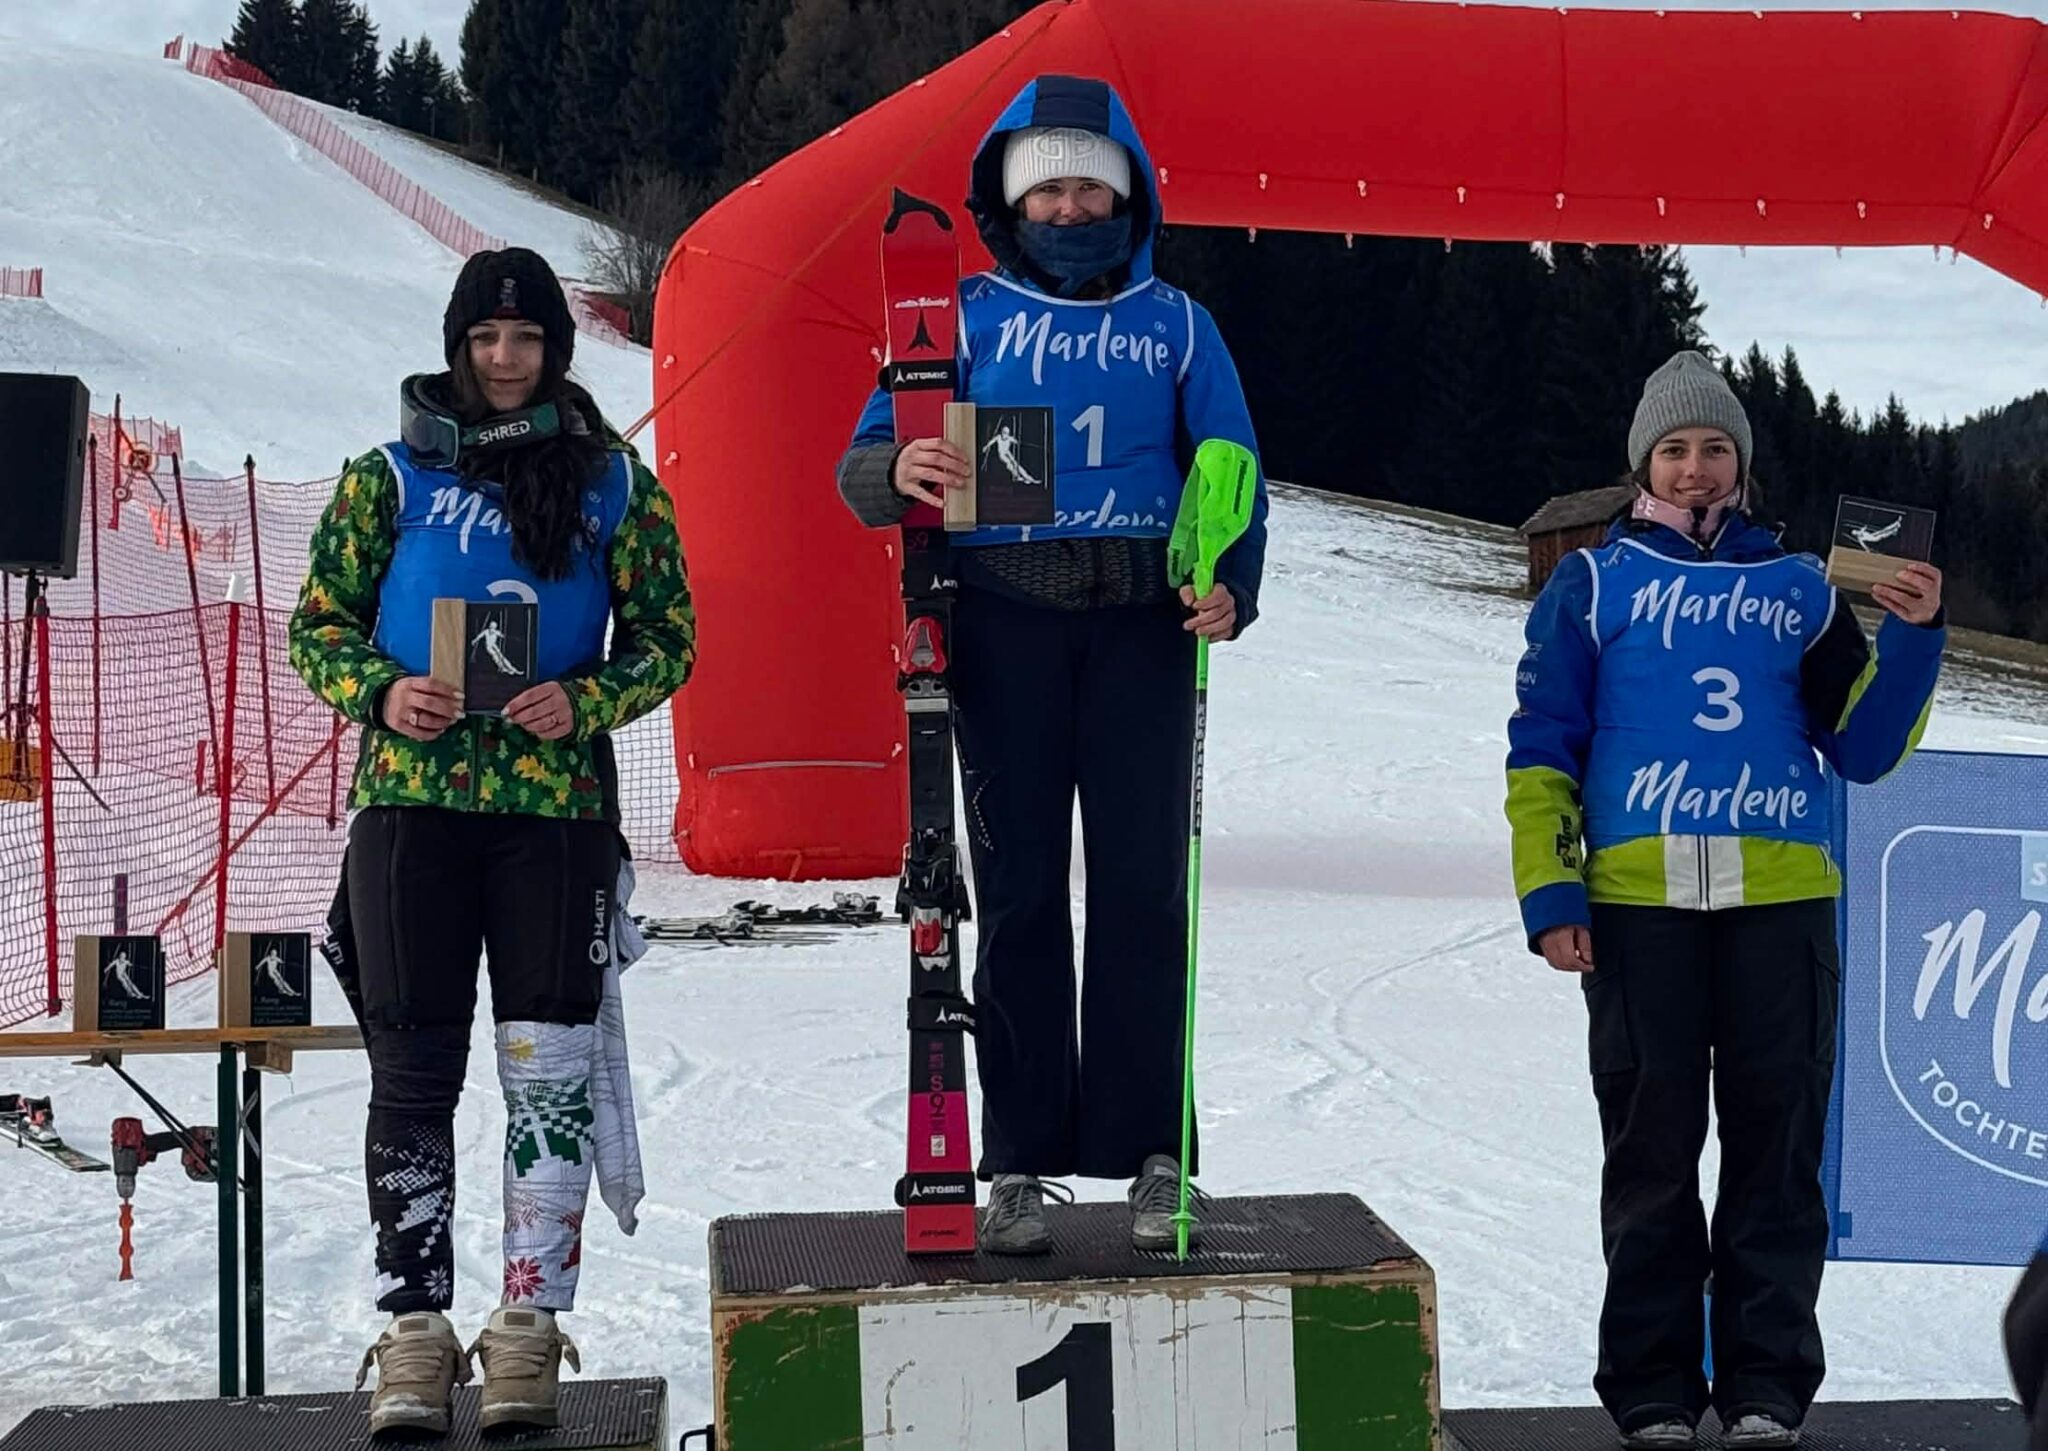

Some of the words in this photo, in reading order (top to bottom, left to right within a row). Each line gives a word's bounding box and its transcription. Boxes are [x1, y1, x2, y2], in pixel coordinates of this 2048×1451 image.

[906, 371, 949, 380] ATOMIC
[996, 311, 1169, 386] Marlene
[479, 420, 530, 445] SHRED
[1071, 404, 1104, 467] 1
[1630, 574, 1802, 650] Marlene
[1691, 666, 1744, 732] 3
[1625, 759, 1809, 834] Marlene
[593, 889, 606, 936] HALTI
[922, 1184, 966, 1194] ATOMIC
[1016, 1322, 1114, 1451] 1
